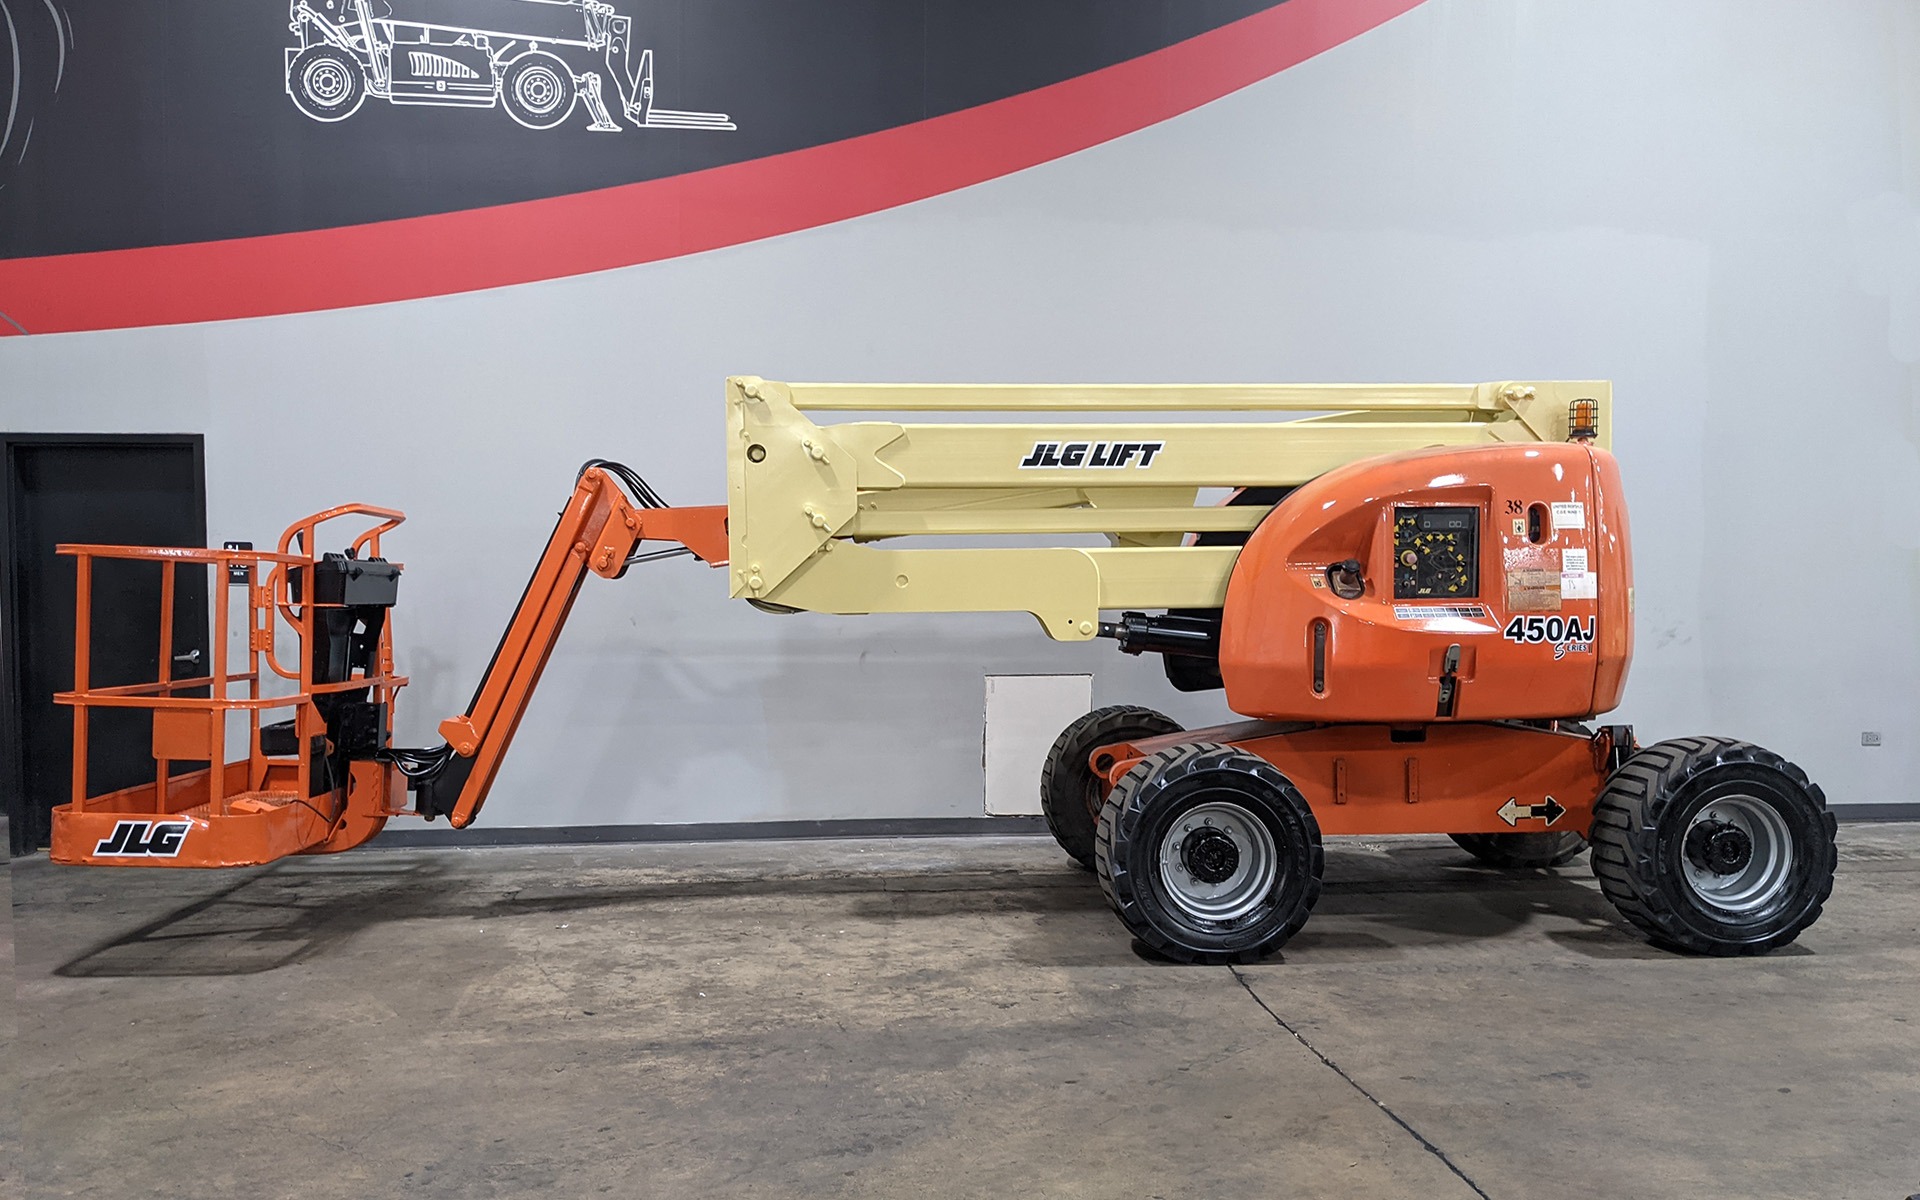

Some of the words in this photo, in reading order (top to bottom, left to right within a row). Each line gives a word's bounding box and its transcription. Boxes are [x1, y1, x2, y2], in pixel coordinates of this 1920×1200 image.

[1020, 442, 1090, 468] JLG
[1087, 442, 1164, 468] LIFT
[1504, 499, 1523, 515] 38
[1504, 616, 1595, 643] 450AJ
[1554, 641, 1588, 660] SERIES
[93, 821, 193, 856] JLG
